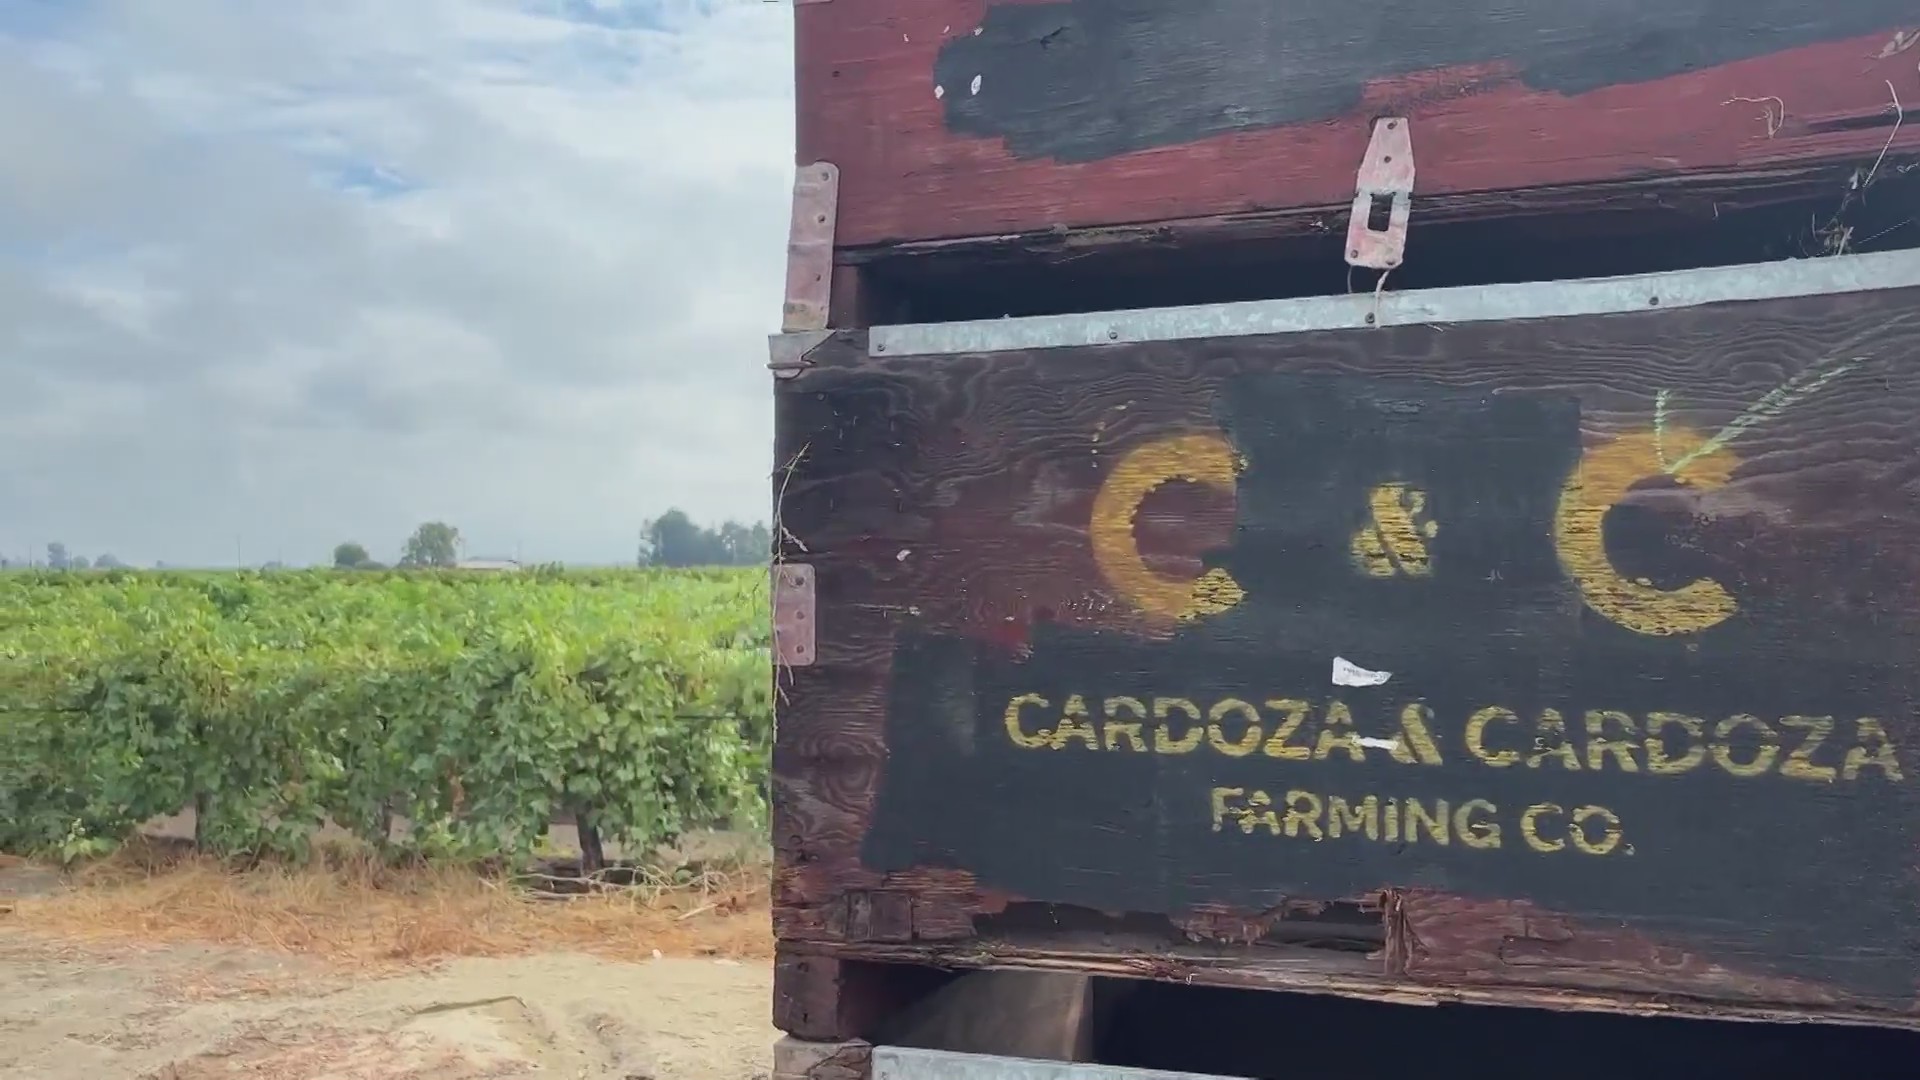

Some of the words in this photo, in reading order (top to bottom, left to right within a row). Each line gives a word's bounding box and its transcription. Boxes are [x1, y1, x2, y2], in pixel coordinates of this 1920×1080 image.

[1090, 433, 1246, 626] C
[1350, 481, 1438, 578] &
[1554, 428, 1738, 636] C
[1004, 692, 1366, 762] CARDOZA
[1464, 705, 1904, 784] CARDOZA
[1210, 787, 1501, 849] FARMING
[1519, 802, 1635, 857] CO.
